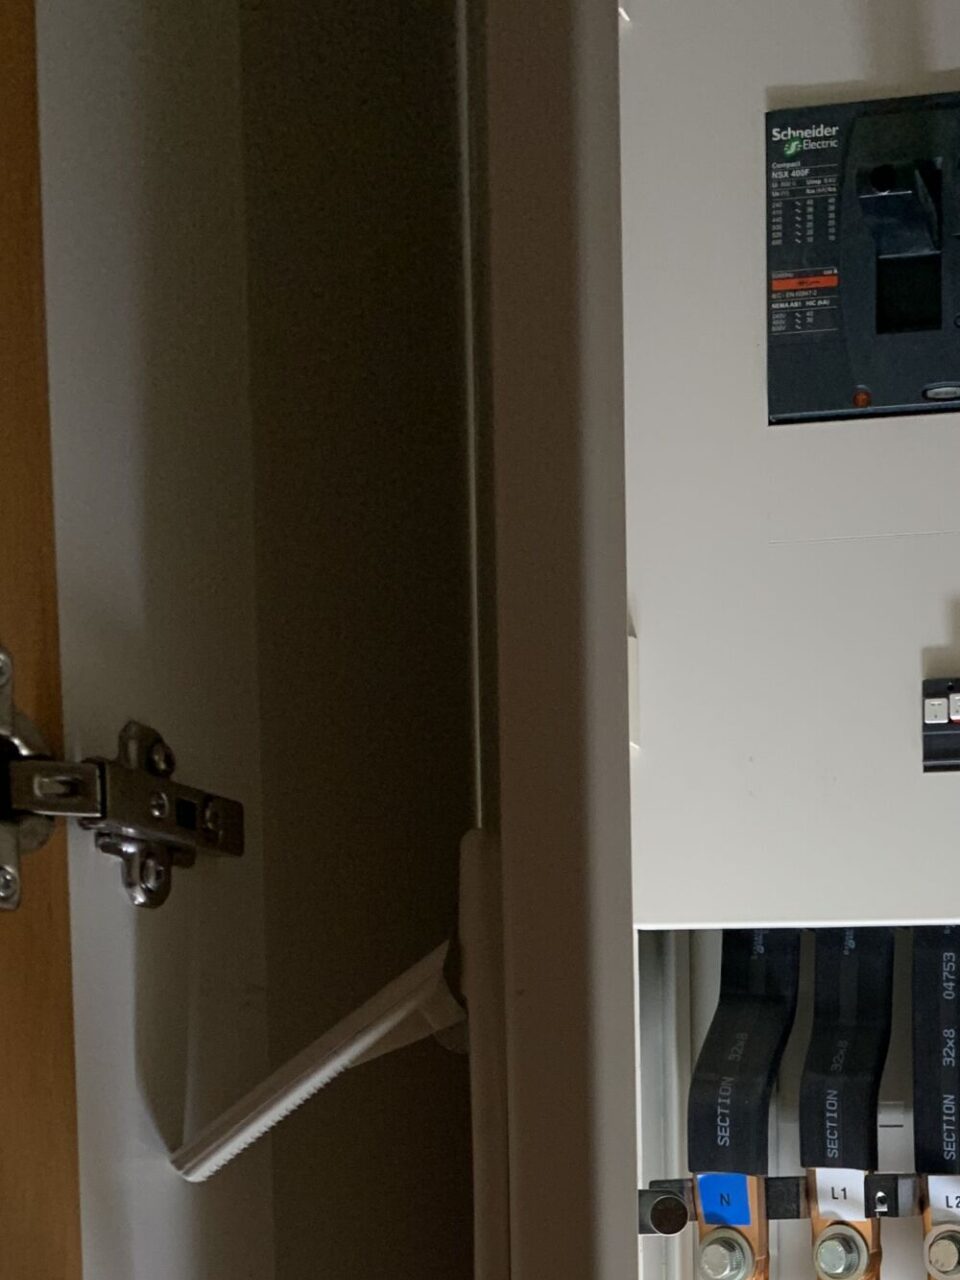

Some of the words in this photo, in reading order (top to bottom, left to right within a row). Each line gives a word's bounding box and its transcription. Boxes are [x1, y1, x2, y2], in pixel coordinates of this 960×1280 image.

[771, 124, 839, 141] Schneider
[802, 138, 838, 150] Electric
[942, 952, 957, 1000] 04753
[942, 1028, 957, 1068] 32x8
[717, 1075, 734, 1147] SECTION
[728, 1031, 749, 1062] 32x8
[825, 1089, 839, 1159] SECTION
[942, 1094, 957, 1161] SECTION
[719, 1192, 731, 1207] N
[831, 1186, 848, 1200] L1
